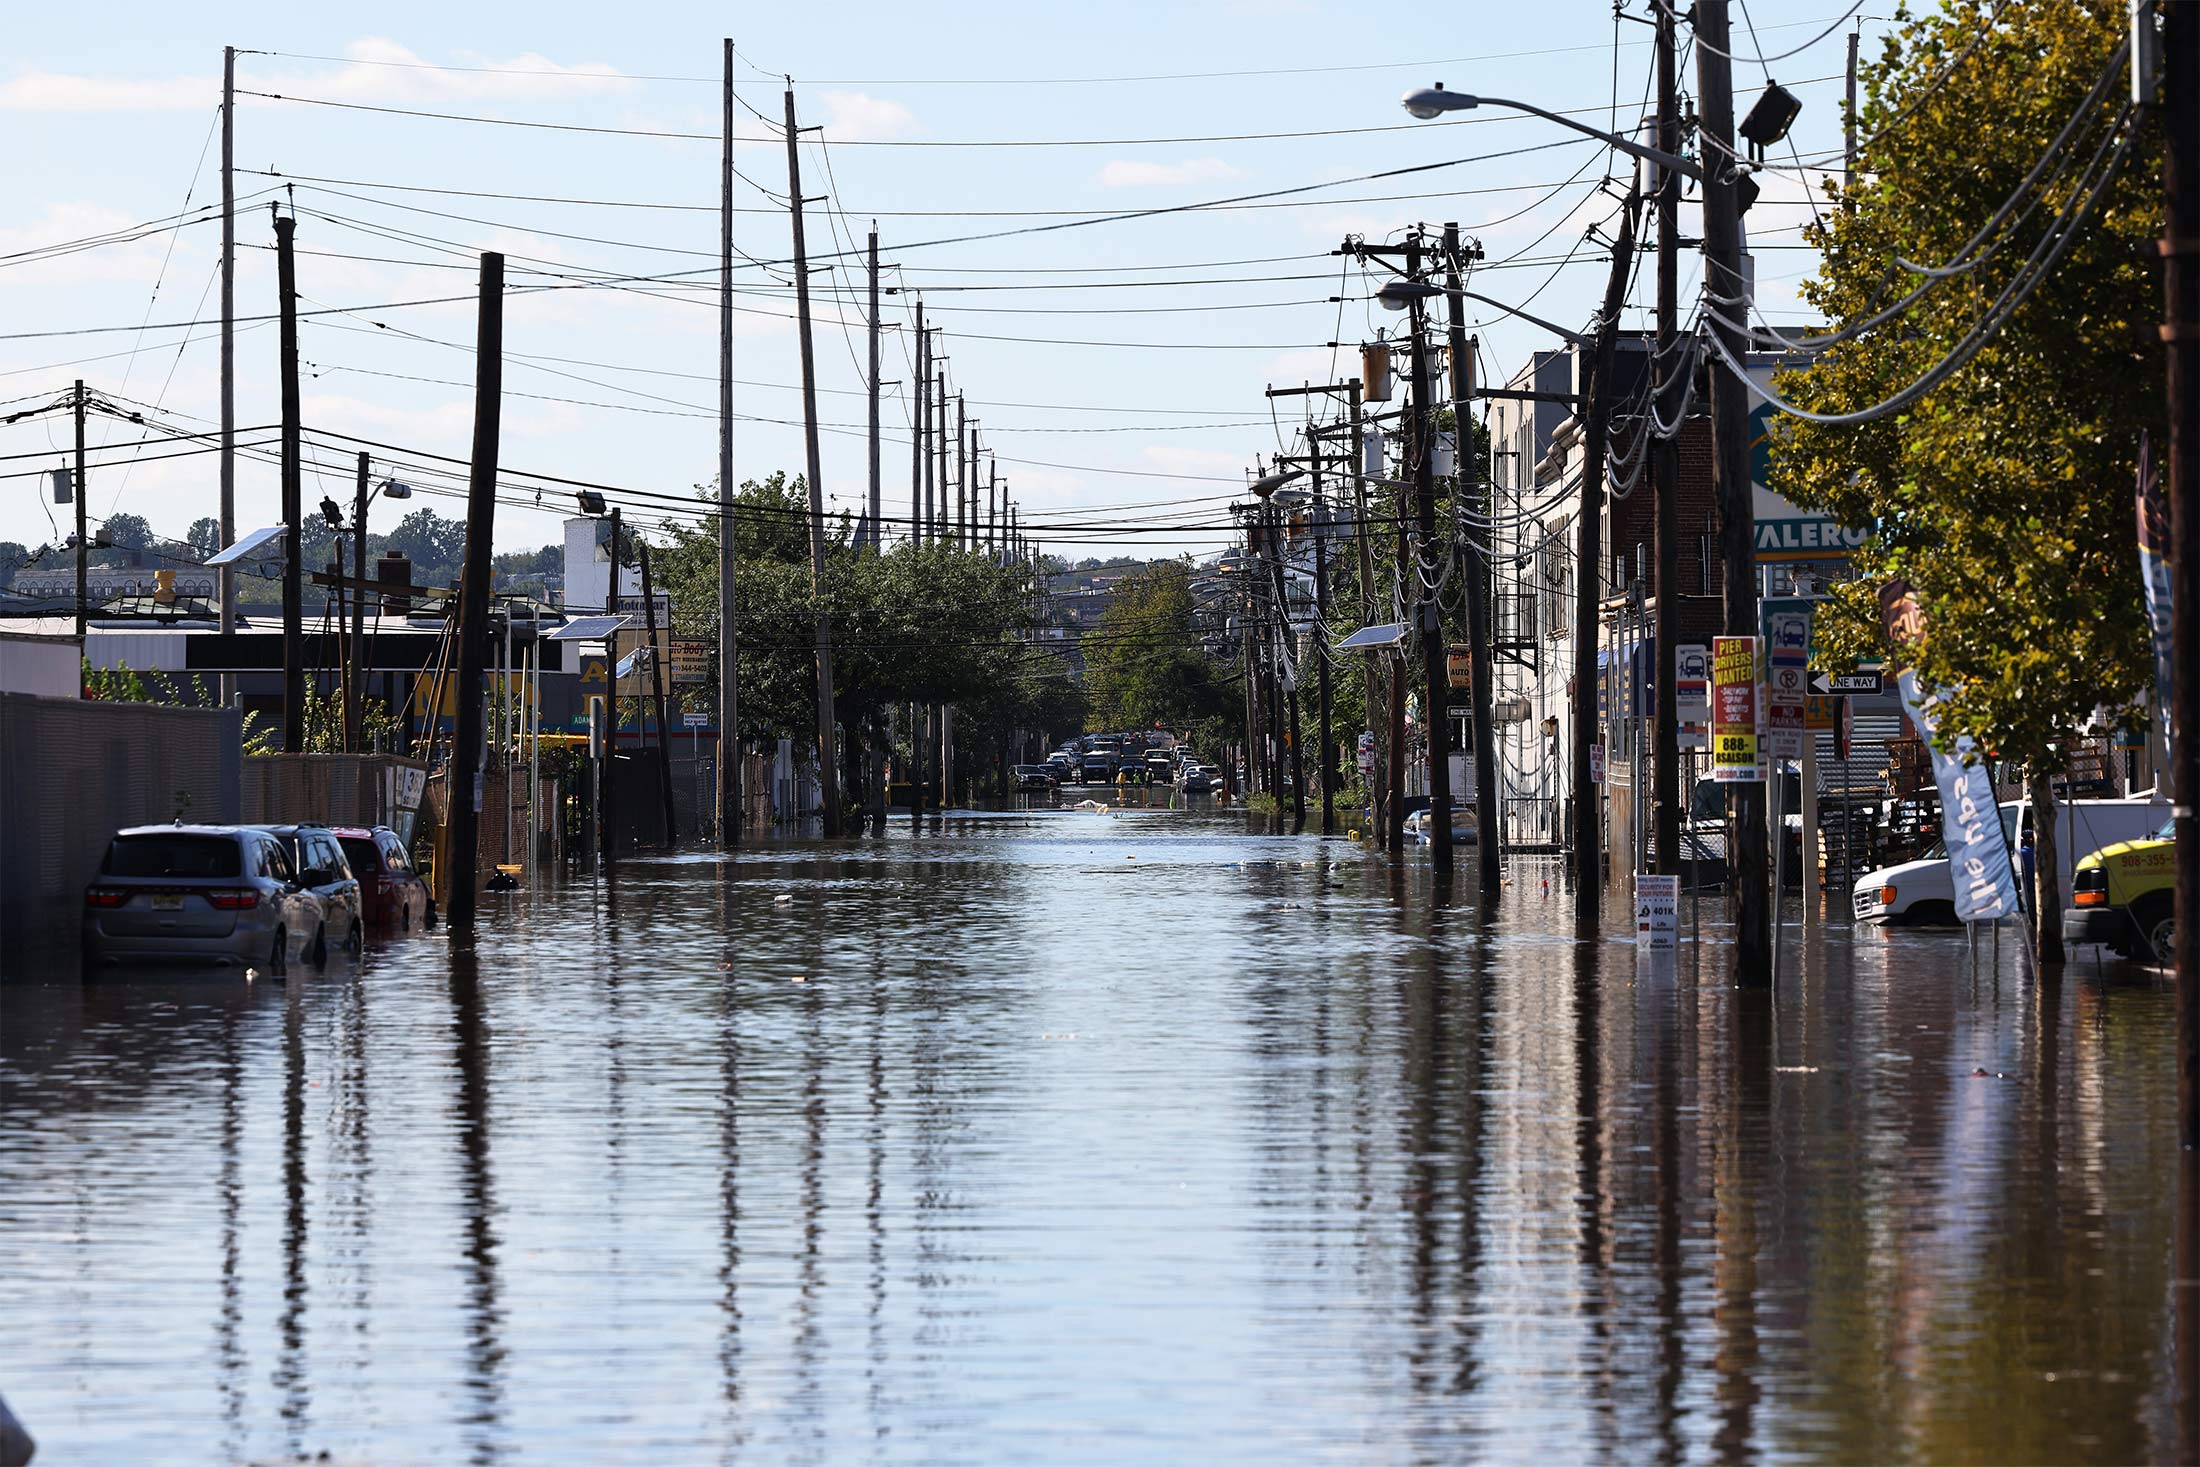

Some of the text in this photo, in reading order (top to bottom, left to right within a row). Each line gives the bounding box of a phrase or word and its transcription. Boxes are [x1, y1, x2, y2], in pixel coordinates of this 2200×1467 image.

[1754, 522, 1868, 549] ALERO
[683, 643, 705, 656] Body
[1719, 639, 1742, 656] PIER
[1715, 652, 1753, 670] DRIVERS
[1715, 666, 1753, 686] WANTED
[1829, 677, 1874, 688] ONE WAY
[1782, 707, 1795, 717] NO
[574, 716, 590, 724] ADAM
[1771, 715, 1803, 725] PARKING
[1722, 738, 1749, 751] 888-
[1716, 752, 1755, 764] 8SALSON
[1716, 769, 1755, 779] salson.com
[1653, 907, 1674, 916] 401K
